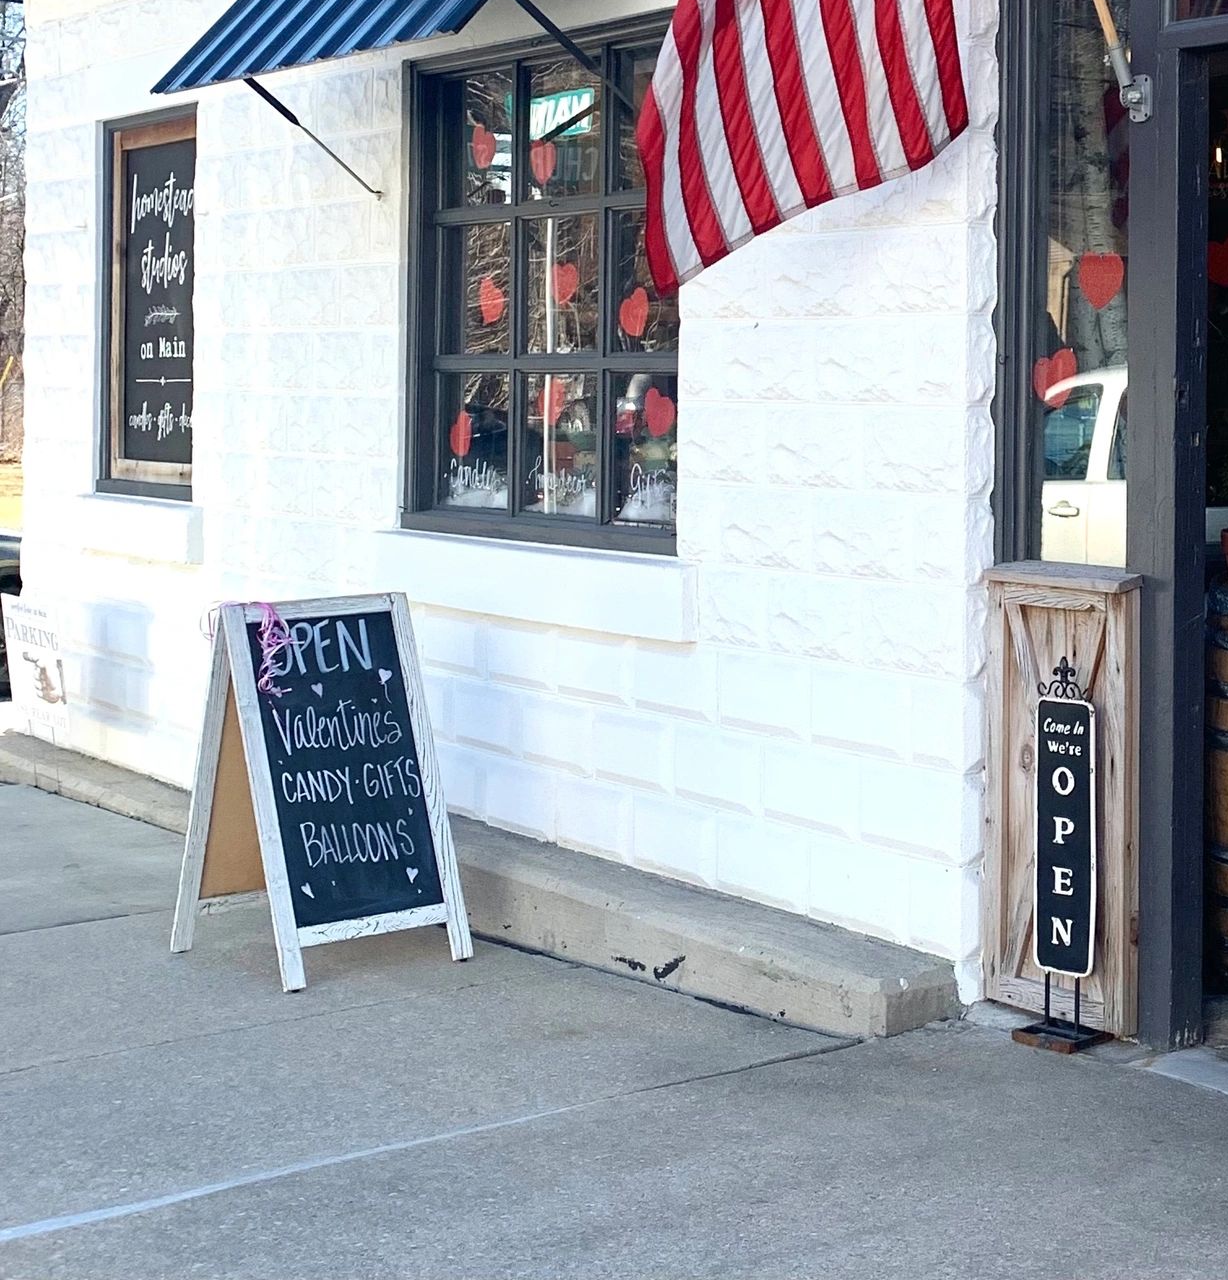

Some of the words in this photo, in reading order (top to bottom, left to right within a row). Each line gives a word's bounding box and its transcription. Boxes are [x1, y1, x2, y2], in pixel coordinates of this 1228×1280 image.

[140, 231, 189, 295] studios
[140, 342, 154, 360] on
[159, 336, 186, 359] Main
[5, 615, 60, 652] PARKING
[266, 618, 373, 677] OPEN
[1043, 718, 1071, 734] Come
[1073, 719, 1085, 735] In
[1047, 740, 1082, 757] We're
[299, 818, 415, 868] BALLOONS
[1050, 766, 1076, 947] OPEN
